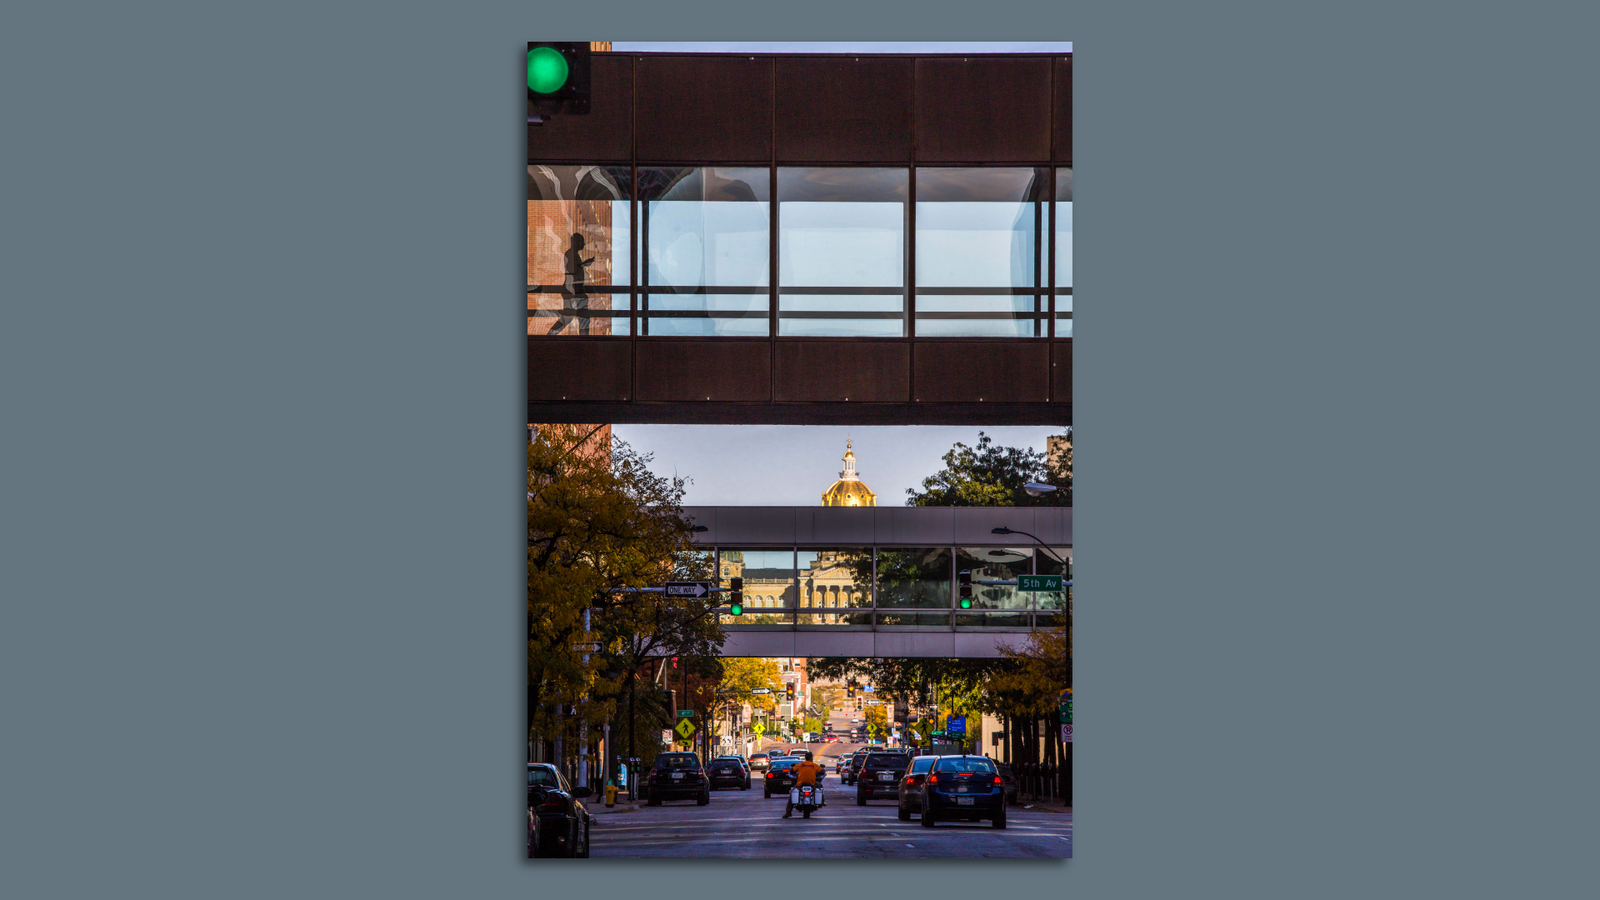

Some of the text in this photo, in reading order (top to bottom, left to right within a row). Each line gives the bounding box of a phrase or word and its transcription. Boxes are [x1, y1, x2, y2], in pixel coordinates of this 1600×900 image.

[1023, 578, 1057, 588] 5th Av
[669, 586, 696, 594] ONE WAY
